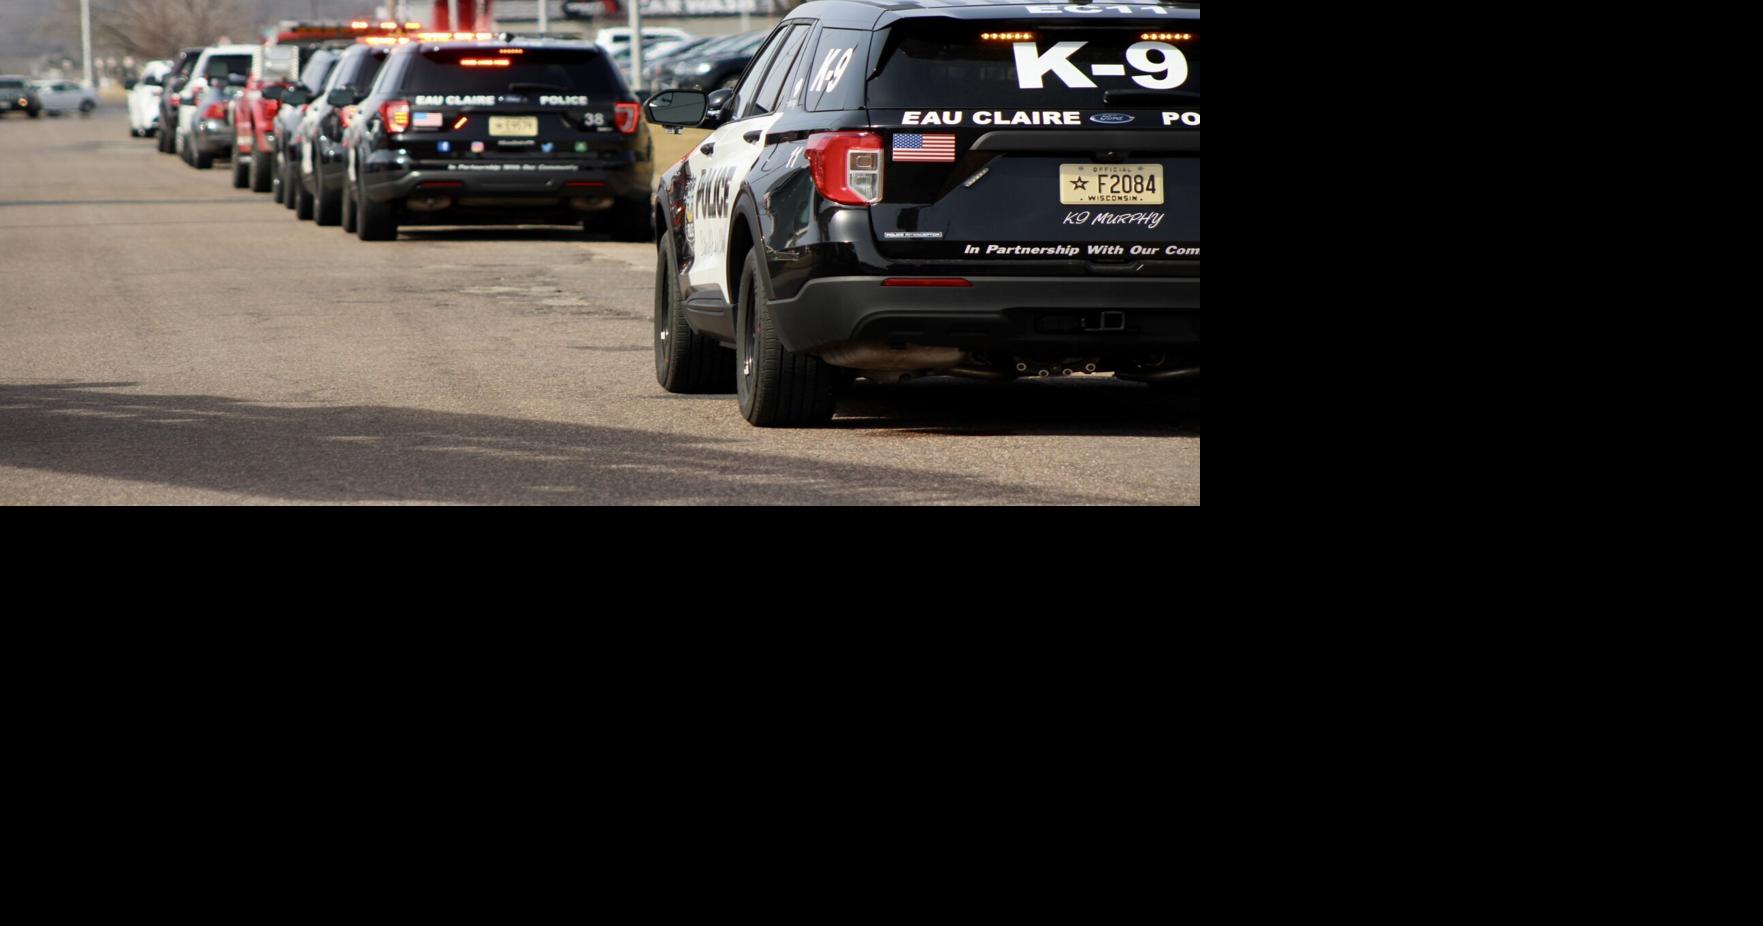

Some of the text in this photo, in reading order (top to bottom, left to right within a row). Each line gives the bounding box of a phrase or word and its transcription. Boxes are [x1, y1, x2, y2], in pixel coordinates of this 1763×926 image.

[809, 47, 854, 93] K-9
[1012, 40, 1189, 90] K-9
[415, 95, 444, 106] EAU
[445, 95, 496, 106] CLAIRE
[539, 95, 588, 106] POLICE
[584, 112, 604, 126] 38
[901, 111, 963, 125] EAU
[972, 111, 1082, 125] CLAIRE
[695, 166, 736, 219] POLICE
[1097, 174, 1156, 194] F2084
[1062, 211, 1165, 229] K9 MURPHY
[964, 244, 980, 254] In
[985, 244, 1080, 256] Partnership
[1086, 244, 1125, 255] With
[1129, 245, 1160, 255] Our
